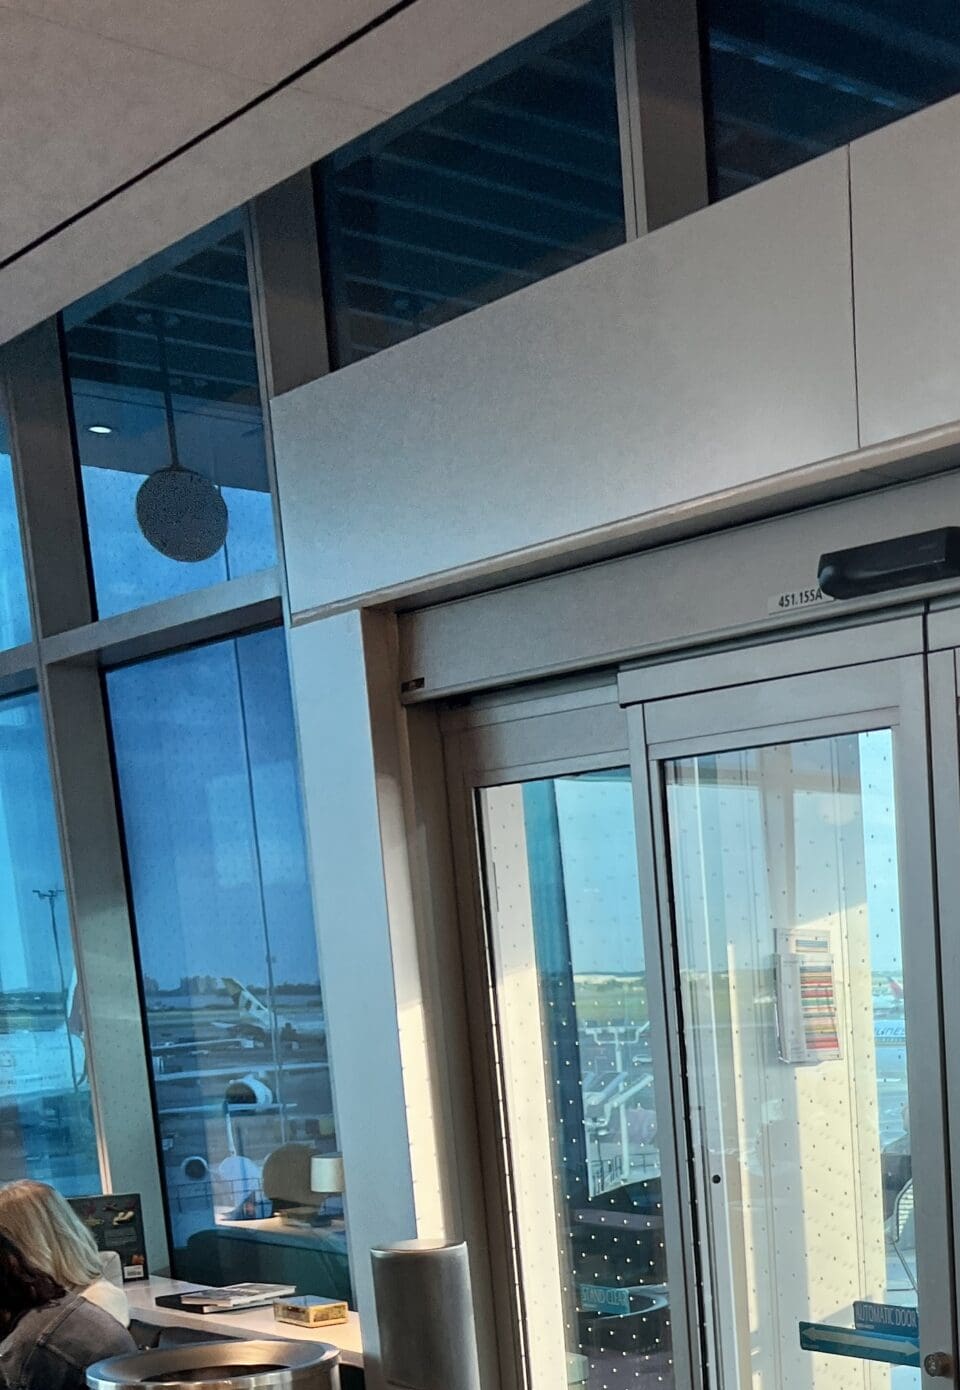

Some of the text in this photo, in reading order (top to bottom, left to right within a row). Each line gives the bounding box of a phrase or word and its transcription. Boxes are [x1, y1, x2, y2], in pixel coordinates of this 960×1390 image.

[778, 588, 823, 608] 451.155A
[857, 1303, 918, 1328] AUTOMATIC DOOR
